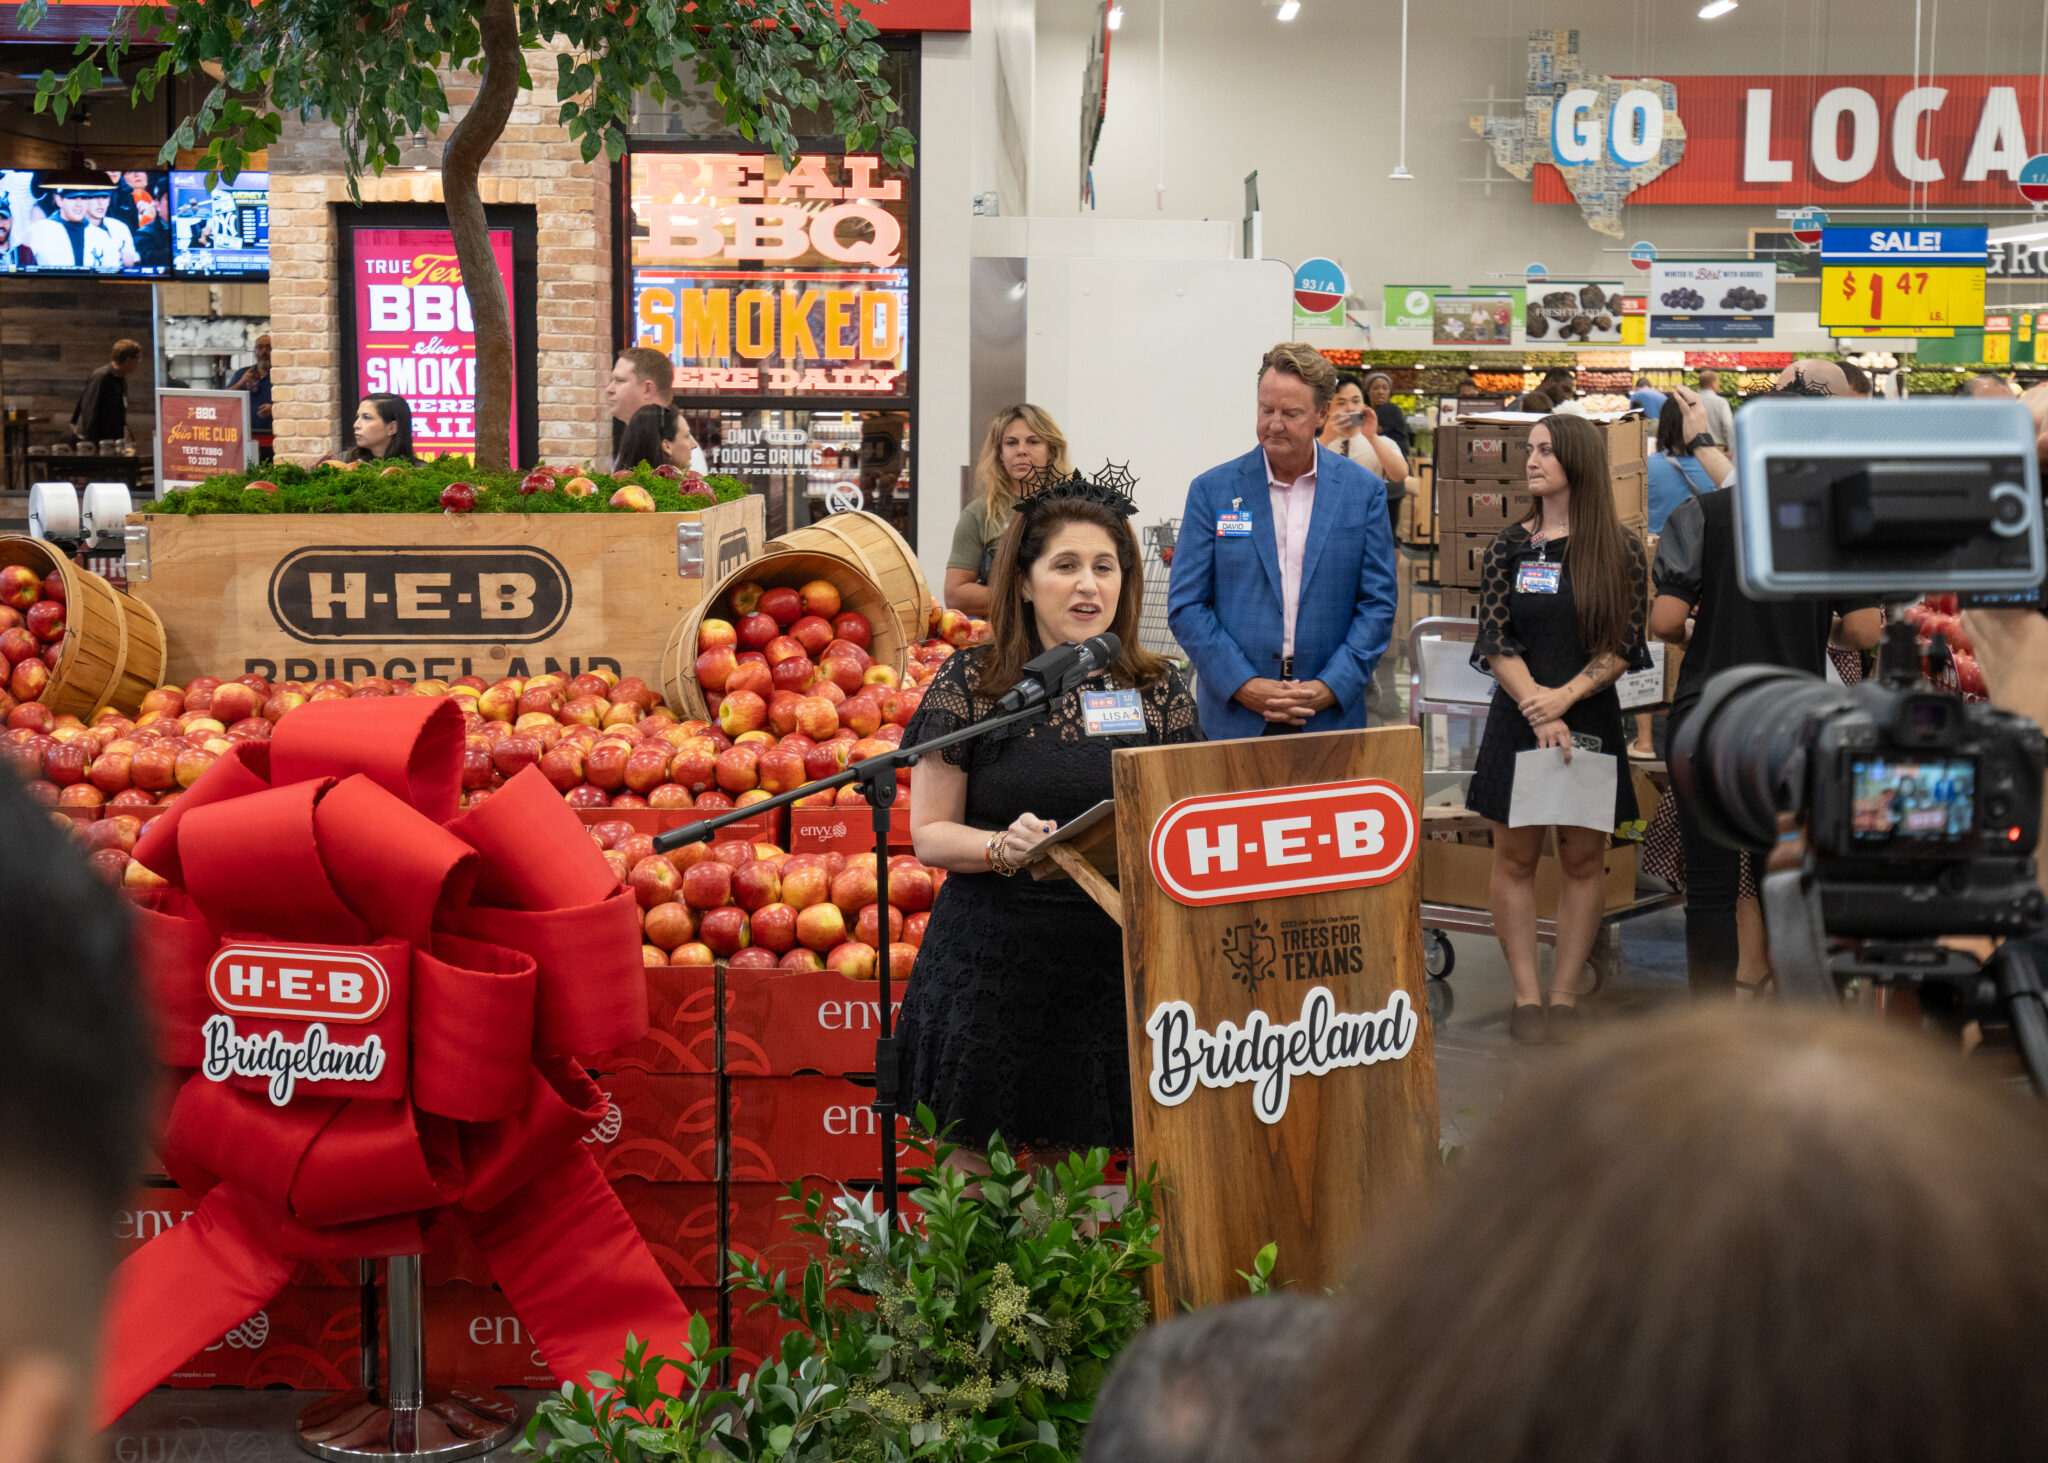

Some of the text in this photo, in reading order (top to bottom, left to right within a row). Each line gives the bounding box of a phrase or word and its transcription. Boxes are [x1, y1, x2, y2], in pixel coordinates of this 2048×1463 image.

[1554, 88, 1665, 164] GO
[638, 155, 902, 200] REAL
[638, 203, 901, 268] BBQ
[1869, 231, 1942, 252] SALE!
[365, 259, 412, 274] TRUE
[1896, 272, 1929, 295] 47
[638, 287, 901, 360] SMOKED
[1396, 314, 1434, 328] Organi
[411, 336, 460, 355] Slow
[366, 357, 476, 395] SMOKE
[672, 367, 901, 391] ERE DAILY
[195, 406, 217, 420] BBQ
[167, 421, 238, 444] Join THE CLUB
[411, 417, 476, 438] AIL
[727, 428, 762, 445] ONLY
[181, 446, 200, 455] TEXT:
[187, 456, 197, 465] TO
[712, 448, 822, 465] FOOD & DRINKS
[708, 467, 739, 475] ARE
[308, 572, 537, 620] H-E-B
[1103, 712, 1130, 721] LISA
[801, 826, 833, 842] envy
[1186, 808, 1386, 876] H-E-B
[1281, 923, 1361, 952] TREES FOR
[1282, 945, 1363, 982] TEXANS
[229, 964, 364, 1004] H-E-B
[818, 999, 901, 1030] env
[206, 1020, 380, 1101] Bridgeland
[1155, 994, 1412, 1116] Bridgeland
[112, 1209, 194, 1239] env
